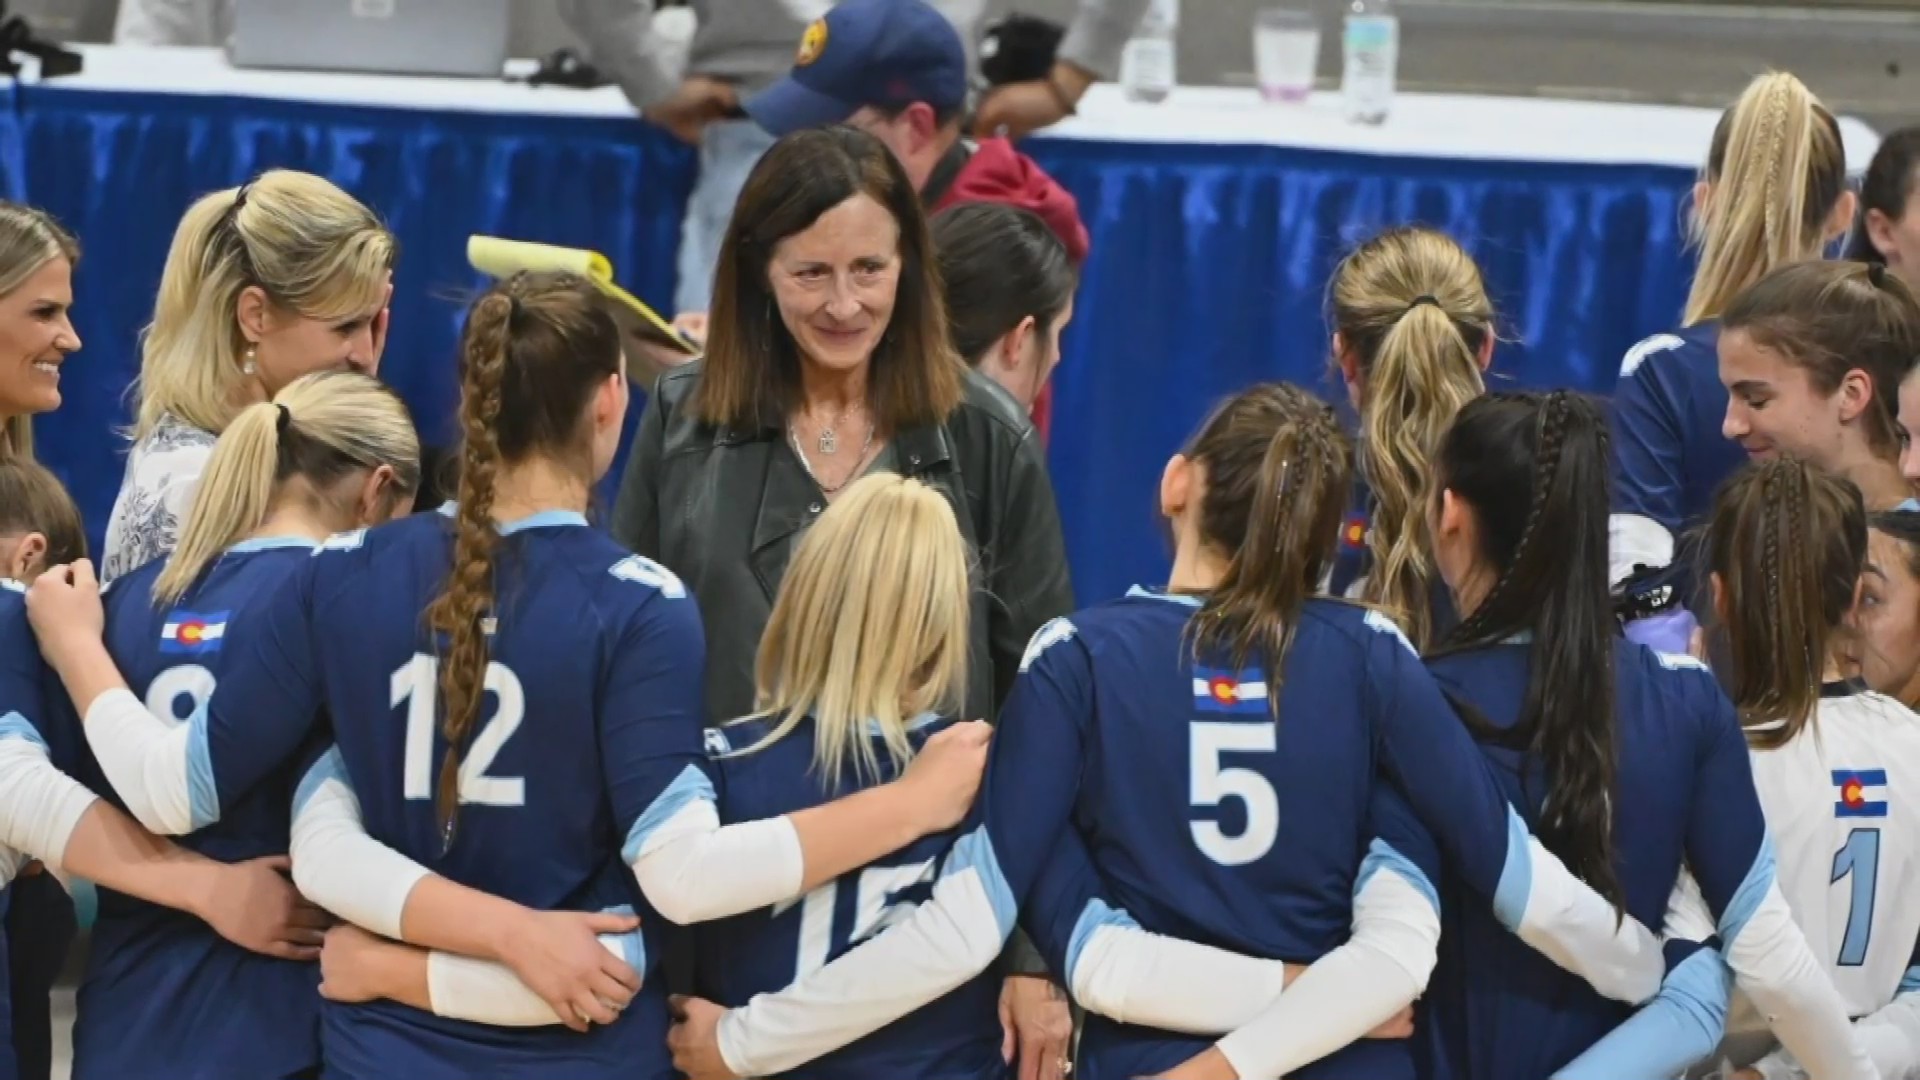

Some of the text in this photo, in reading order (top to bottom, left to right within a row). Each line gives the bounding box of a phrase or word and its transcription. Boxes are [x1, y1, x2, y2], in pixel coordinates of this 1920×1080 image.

[389, 652, 526, 806] 12
[1189, 721, 1279, 867] 5
[1830, 827, 1880, 966] 1
